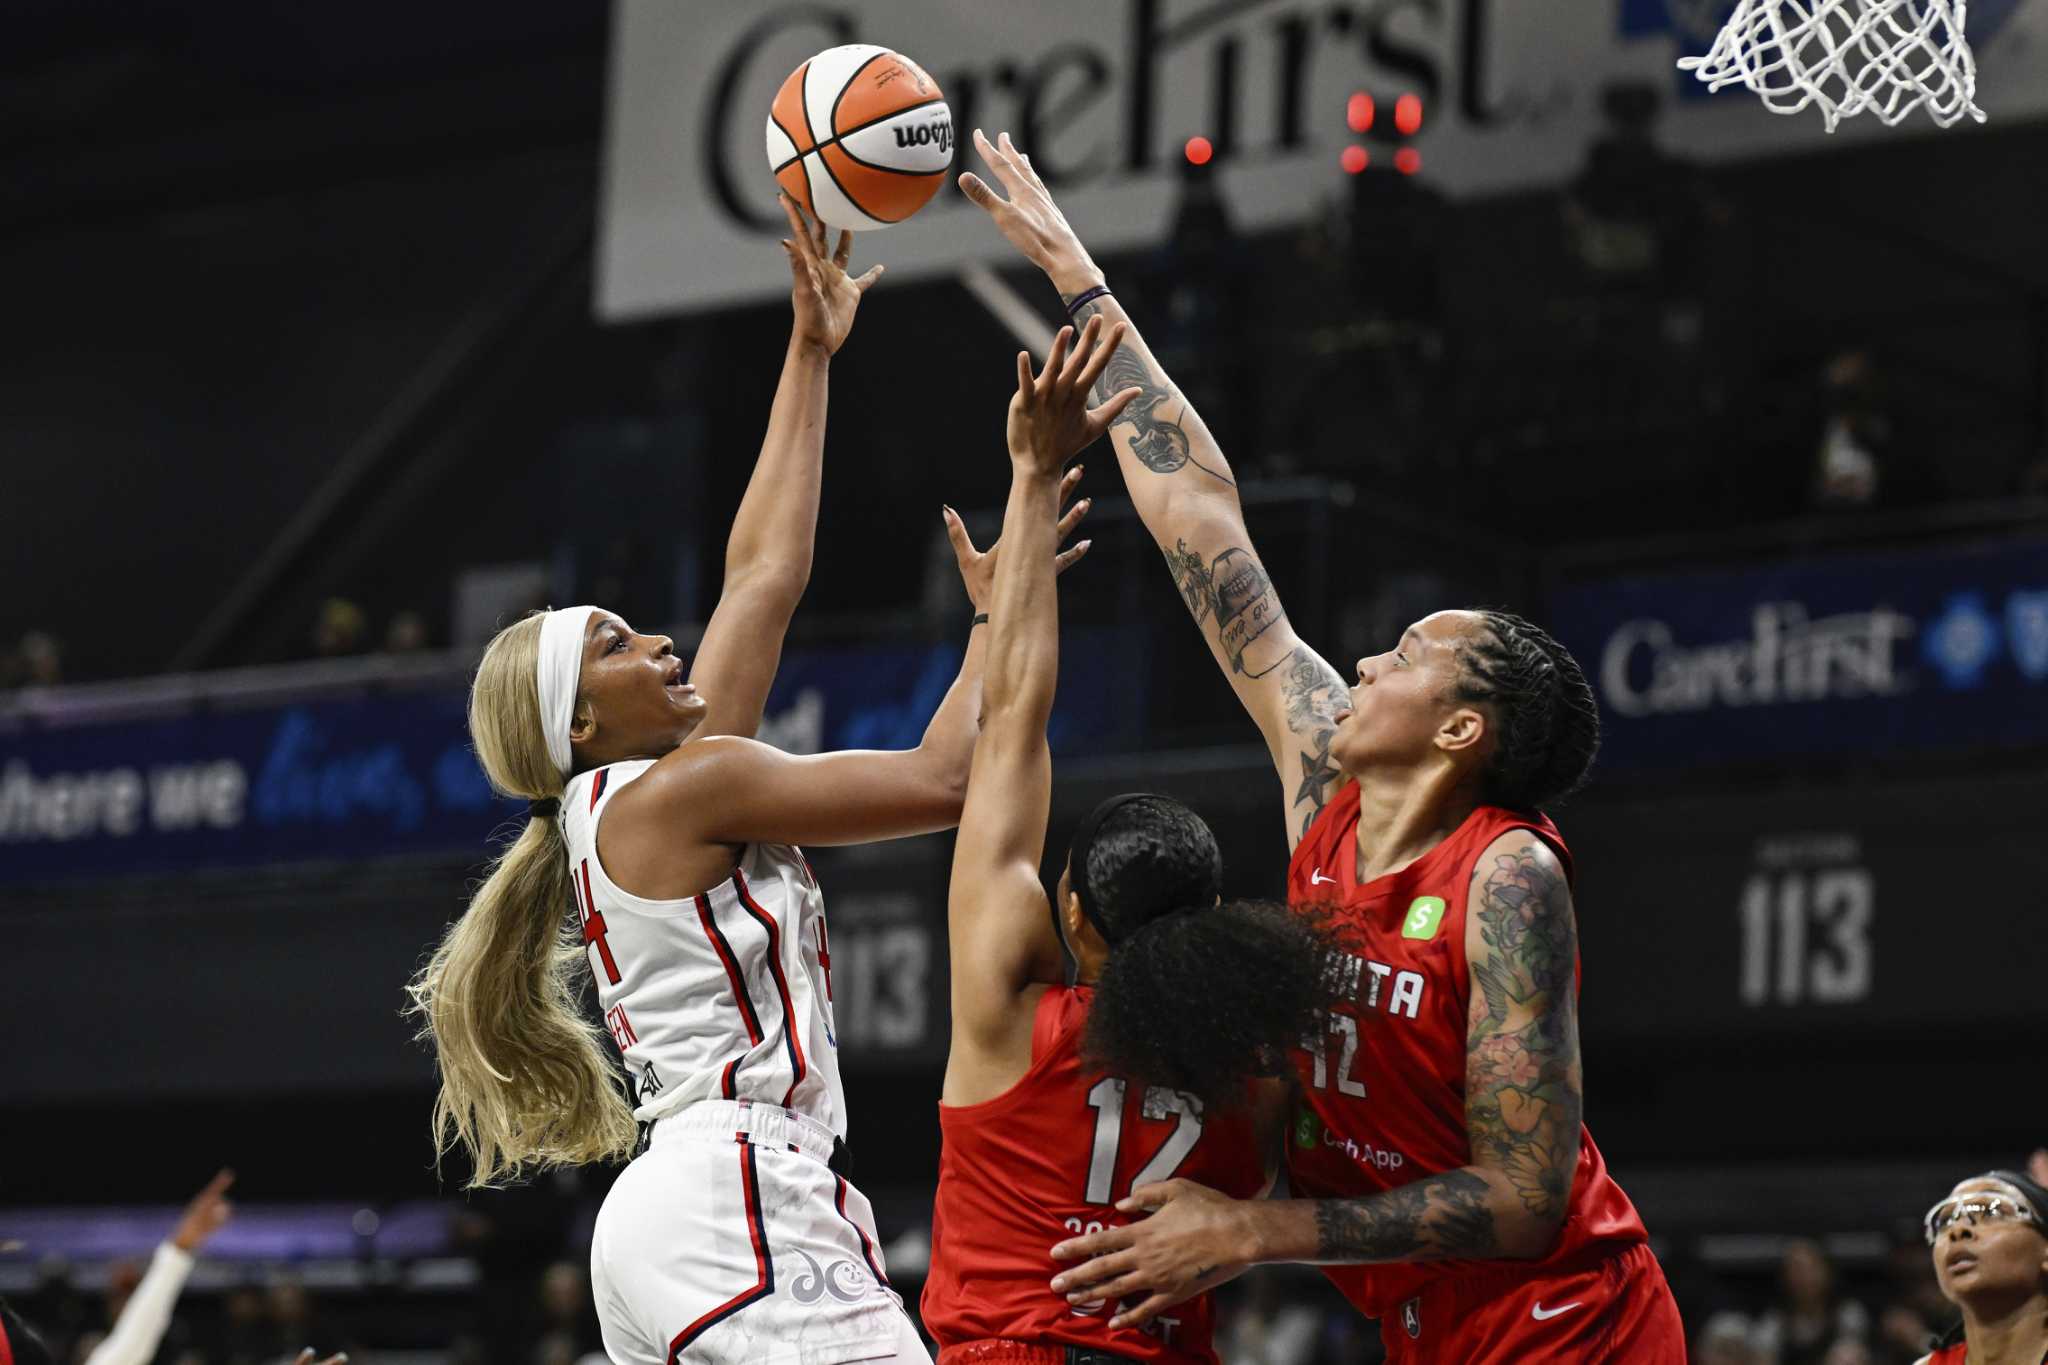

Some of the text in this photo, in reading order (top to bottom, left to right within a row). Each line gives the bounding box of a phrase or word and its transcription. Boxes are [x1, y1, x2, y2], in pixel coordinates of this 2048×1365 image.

[700, 0, 1508, 233] CreFirst
[893, 119, 954, 153] ilson
[0, 761, 142, 840] here
[1739, 868, 1876, 1007] 113
[1086, 1076, 1205, 1214] 12
[1361, 1143, 1403, 1172] App
